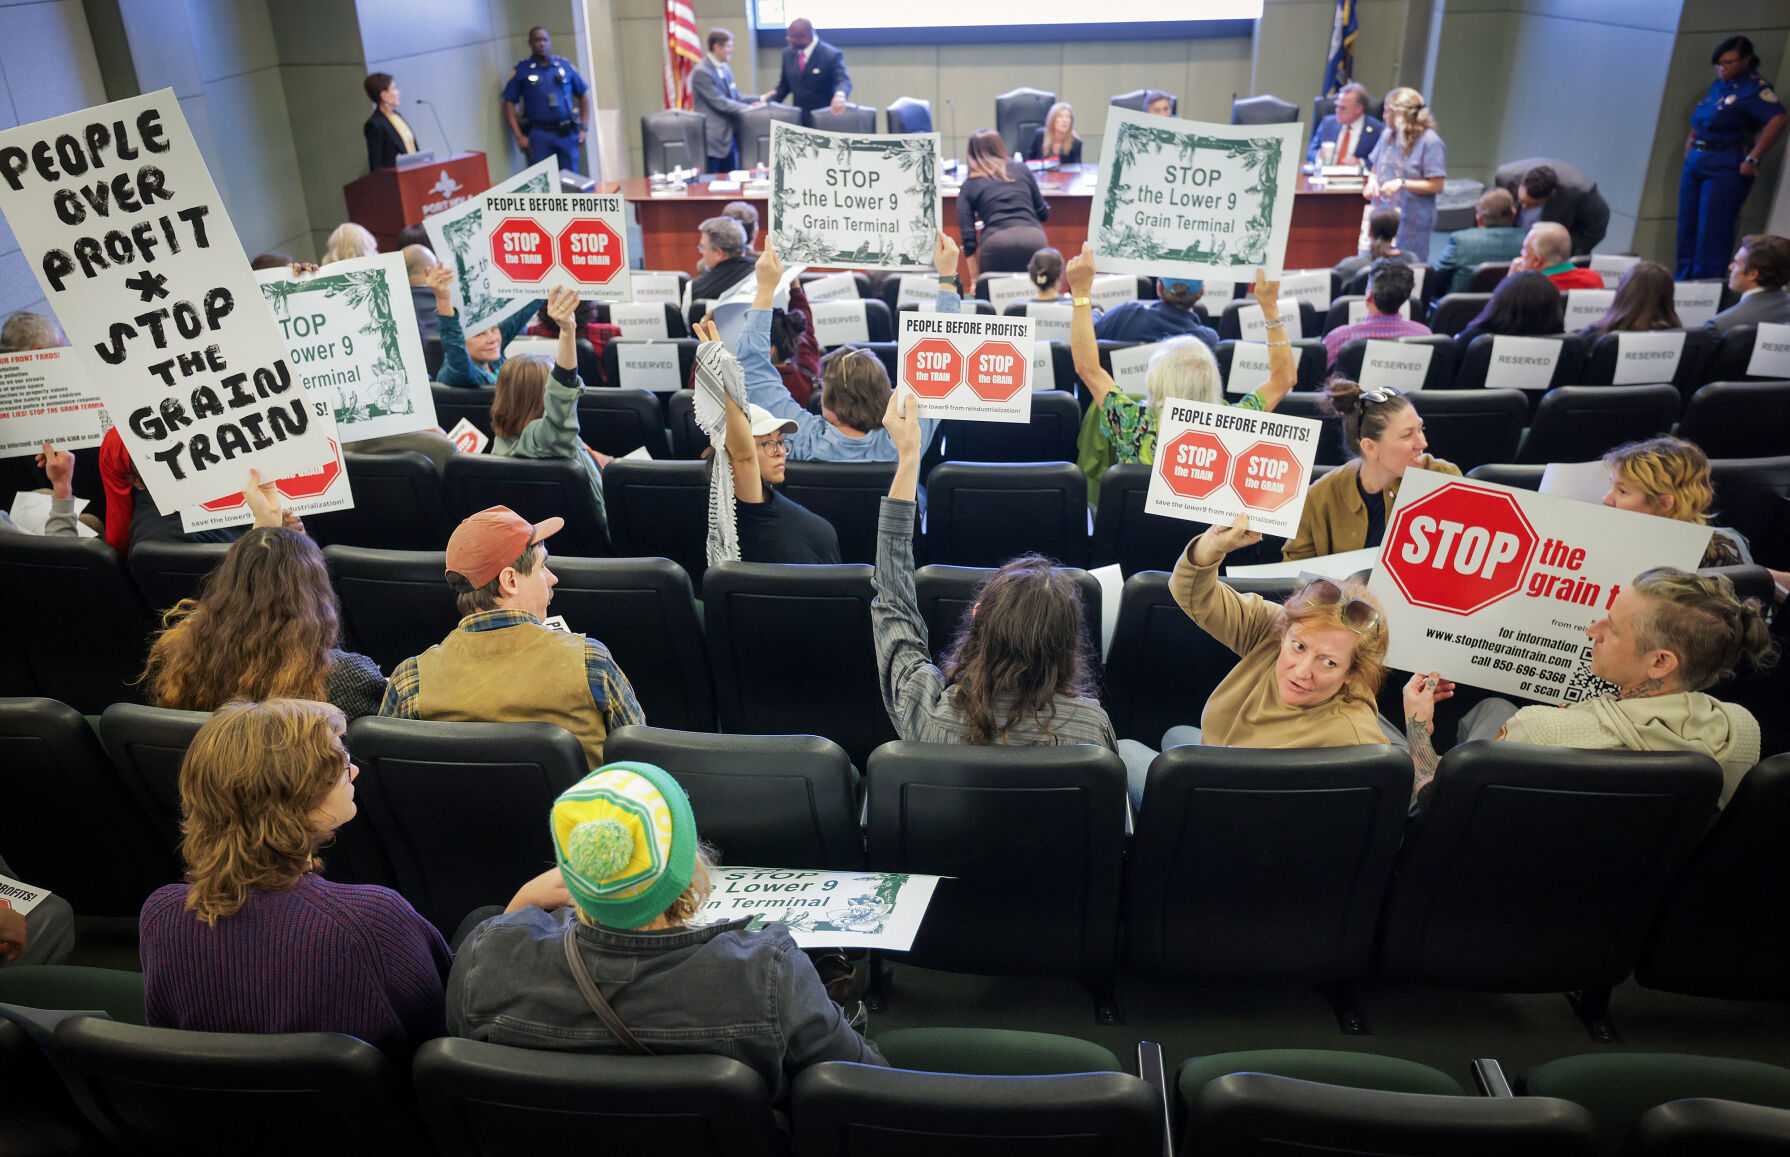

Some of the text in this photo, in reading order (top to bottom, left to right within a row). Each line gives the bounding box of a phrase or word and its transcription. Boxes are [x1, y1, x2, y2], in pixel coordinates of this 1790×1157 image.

[0, 108, 170, 190] PEOPLE
[826, 168, 880, 188] STOP
[1164, 165, 1222, 187] STOP
[53, 164, 175, 226] OVER
[803, 189, 898, 210] the Lower 9
[1138, 185, 1237, 210] the Lower 9
[487, 198, 526, 211] PEOPLE
[530, 199, 569, 211] BEFORE
[572, 199, 620, 212] PROFITS!
[803, 214, 899, 233] Grain Terminal
[1135, 211, 1235, 233] Grain Terminal
[42, 205, 209, 292] PROFIT
[503, 232, 540, 252] STOP
[570, 234, 609, 253] STOP
[505, 254, 542, 264] the TRAIN
[572, 255, 611, 265] the GRAIN
[95, 287, 234, 365] STOP
[279, 313, 326, 340] TOP
[617, 317, 660, 326] RESERVED
[816, 315, 860, 325] RESERVED
[907, 320, 1027, 337] PEOPLE BEFORE PROFITS!
[290, 335, 354, 365] ower 9
[1625, 351, 1674, 360] RESERVED
[1762, 342, 1790, 352] RESER
[11, 354, 33, 363] FRONT
[35, 352, 60, 360] YARDS!
[148, 344, 227, 388] THE
[625, 361, 673, 369] RESERVED
[917, 352, 951, 370] STOP
[979, 355, 1014, 373] STOP
[1370, 359, 1422, 371] RESERVED
[1498, 355, 1550, 366] RESERVED
[302, 365, 361, 390] erminal
[916, 371, 951, 382] the TRAIN
[978, 374, 1013, 385] the GRAIN
[30, 408, 44, 416] STOP
[81, 402, 104, 410] TERMIN
[128, 359, 292, 441] GRAIN
[1171, 407, 1310, 442] PEOPLE BEFORE PROFITS!
[154, 398, 309, 481] TRAIN
[1176, 444, 1217, 468] STOP
[1174, 466, 1214, 482] the TRAIN
[1247, 456, 1289, 480] STOP
[1245, 477, 1285, 494] the GRAIN
[1155, 499, 1170, 507] save
[1172, 501, 1183, 509] the
[1184, 503, 1208, 513] lower9
[1208, 507, 1225, 516] from
[191, 512, 251, 527] save the lower9
[1401, 515, 1520, 580] STOP
[1539, 538, 1587, 571] the
[1526, 571, 1601, 606] grain
[1552, 619, 1572, 629] from
[1426, 627, 1572, 668] www.stopthegraintrain.com
[1499, 627, 1578, 654] for information
[1471, 655, 1567, 684] call 850-696-6368
[1520, 681, 1560, 698] or scan
[724, 872, 819, 880] STOP
[725, 881, 815, 893] Lower
[821, 880, 839, 891] 9
[731, 896, 831, 909] Terminal
